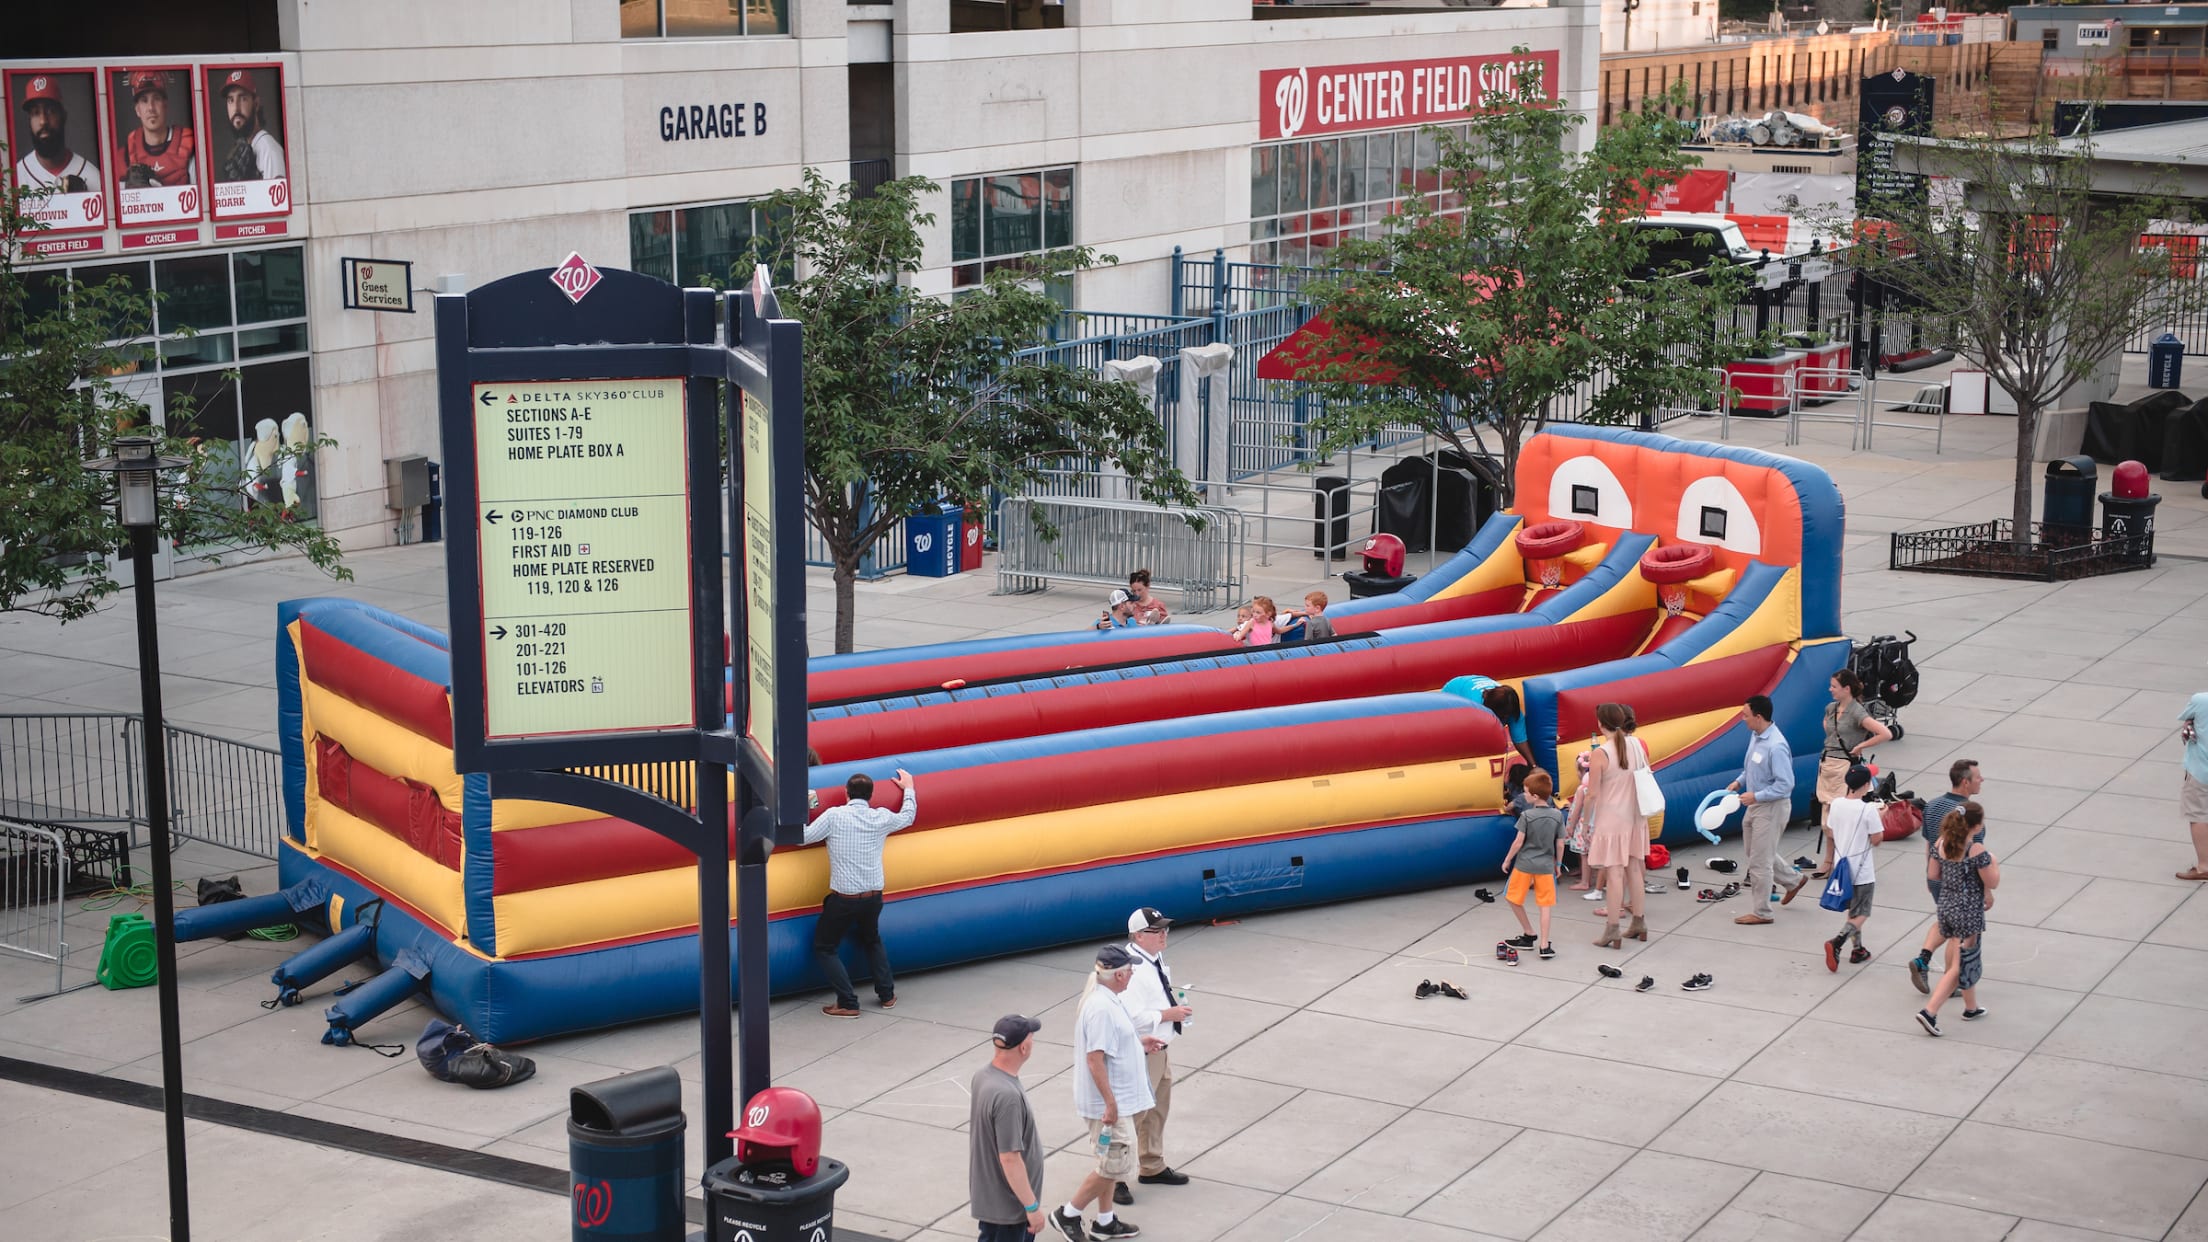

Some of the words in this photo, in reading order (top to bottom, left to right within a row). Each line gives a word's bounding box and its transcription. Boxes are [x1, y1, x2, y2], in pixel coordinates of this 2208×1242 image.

[1317, 71, 1404, 125] CENTER
[1412, 64, 1471, 115] FIELD
[660, 103, 745, 141] GARAGE
[754, 102, 767, 136] B
[121, 192, 141, 203] JOSE
[215, 185, 248, 197] TANNER
[121, 203, 164, 215] LOBATON
[215, 197, 246, 208] ROARK
[238, 225, 266, 236] PITCHER
[37, 241, 66, 252] CENTER
[68, 240, 89, 250] FIELD
[145, 233, 177, 244] CATCHER
[361, 281, 388, 293] Guest
[362, 293, 403, 305] Services
[523, 393, 571, 402] DELTA
[507, 408, 567, 422] SECTIONS
[571, 407, 592, 421] A-E
[508, 427, 550, 441] SUITES
[556, 426, 583, 440] 1-79
[509, 446, 543, 460] HOME
[548, 445, 584, 459] PLATE
[589, 444, 613, 458] BOX
[617, 444, 624, 457] A
[527, 511, 554, 521] PNC
[558, 508, 607, 519] DIAMOND
[611, 507, 639, 518] CLUB
[512, 526, 562, 541] 119-126
[512, 545, 547, 559] FIRST
[551, 543, 571, 557] AID
[946, 524, 954, 574] RECYCLE
[513, 564, 548, 577] HOME
[553, 561, 588, 575] PLATE
[592, 559, 655, 574] RESERVED
[528, 581, 553, 596] 119,
[558, 580, 579, 594] 120
[584, 579, 593, 593] &
[597, 578, 619, 592] 126
[515, 623, 566, 638] 301-420
[516, 642, 565, 657] 201-221
[517, 661, 567, 676] 101-126
[518, 680, 585, 695] ELEVATORS
[723, 1216, 742, 1226] PLEASE
[742, 1221, 767, 1231] RECYCLE
[800, 1219, 816, 1231] PLEASE
